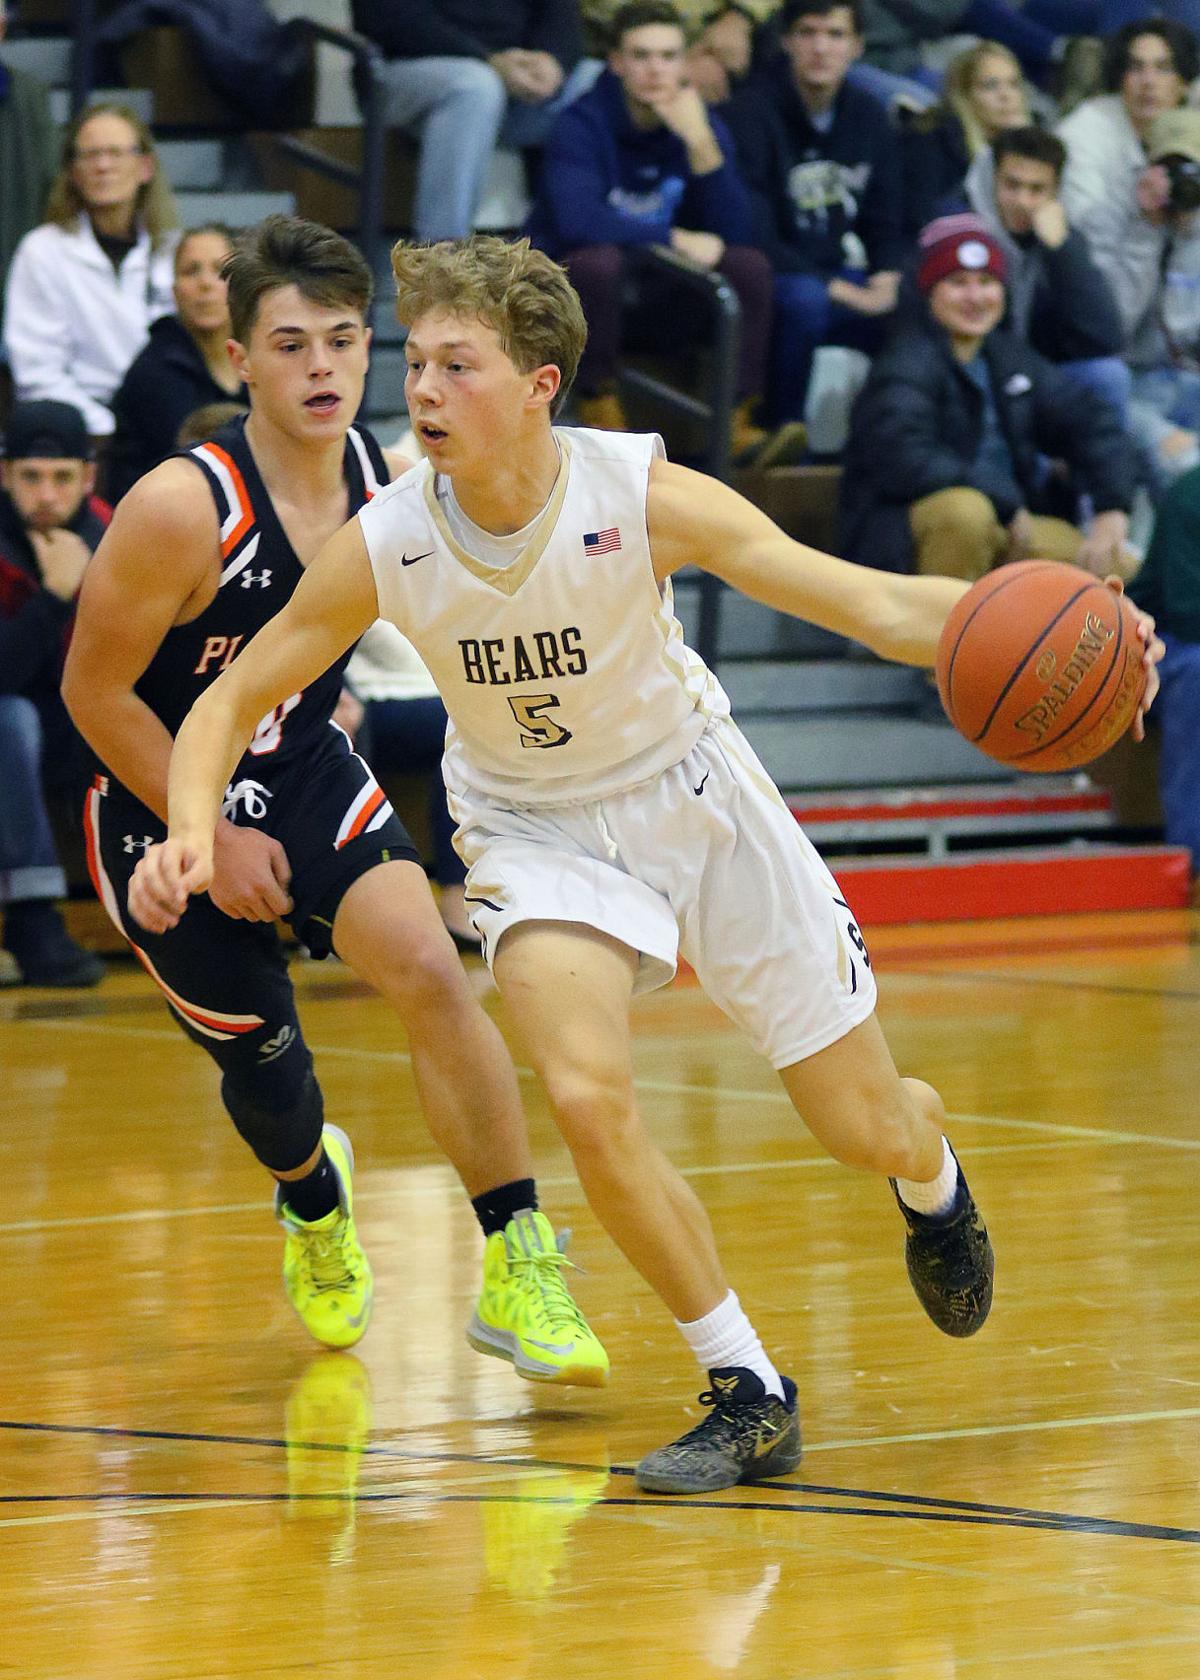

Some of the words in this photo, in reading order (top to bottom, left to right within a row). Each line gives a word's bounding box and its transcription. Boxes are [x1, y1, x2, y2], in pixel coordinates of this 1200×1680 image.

[458, 626, 588, 686] BEARS
[1014, 612, 1115, 743] SPALDING
[507, 693, 573, 749] 5
